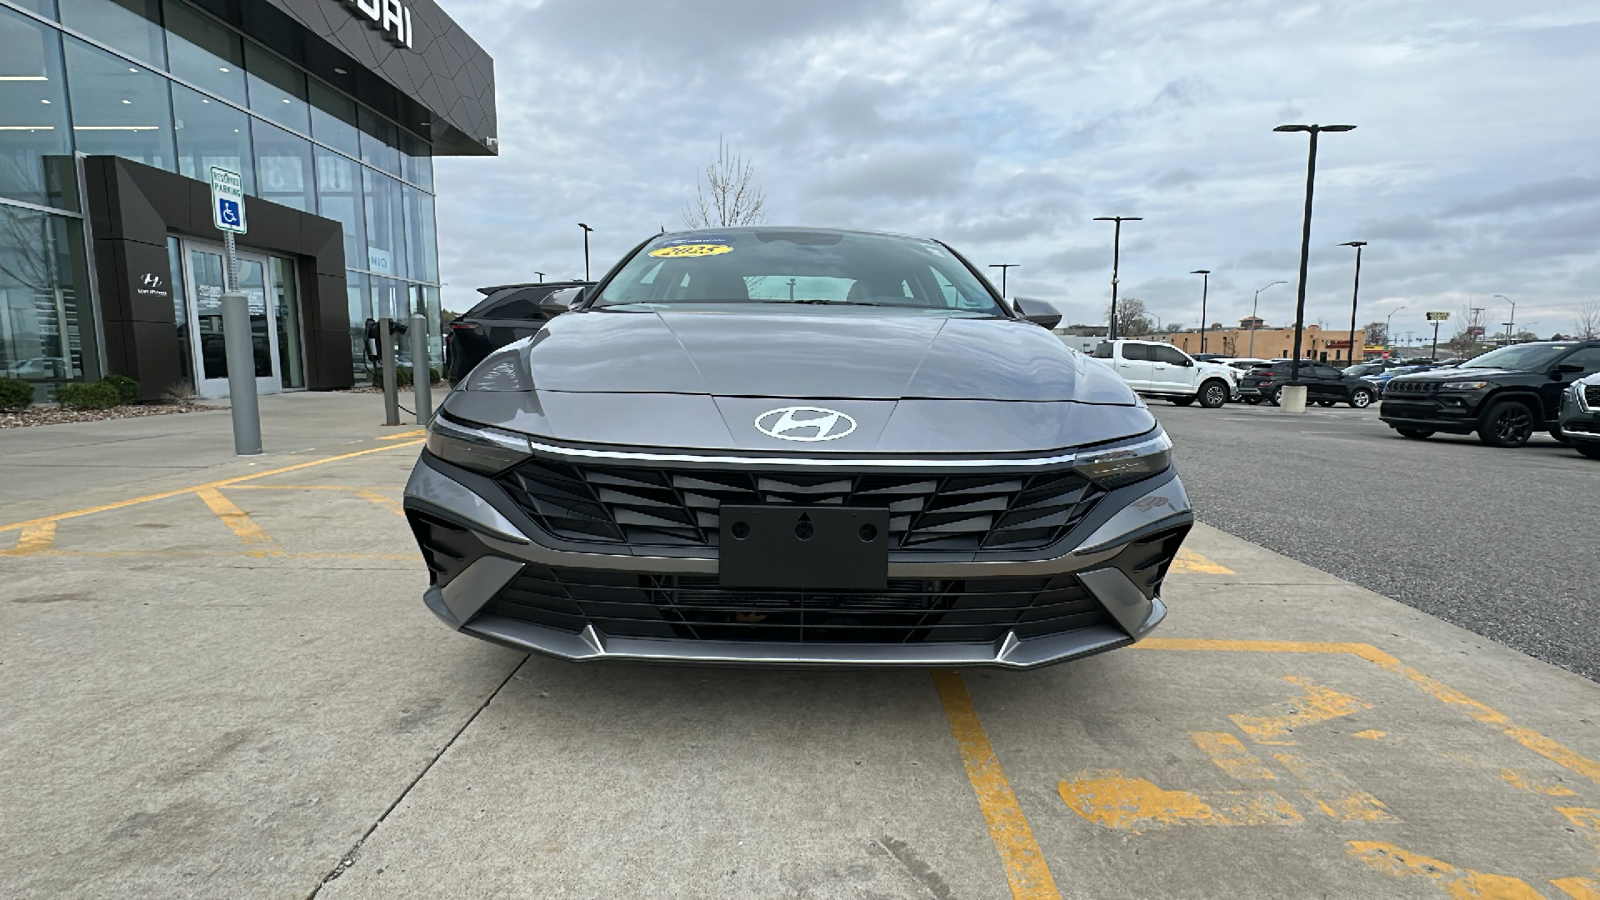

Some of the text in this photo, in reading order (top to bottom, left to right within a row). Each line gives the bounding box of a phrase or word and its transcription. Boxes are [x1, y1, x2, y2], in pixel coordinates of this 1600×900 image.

[213, 172, 240, 187] RESERVED
[214, 182, 241, 198] PARKING
[661, 246, 721, 256] 2025
